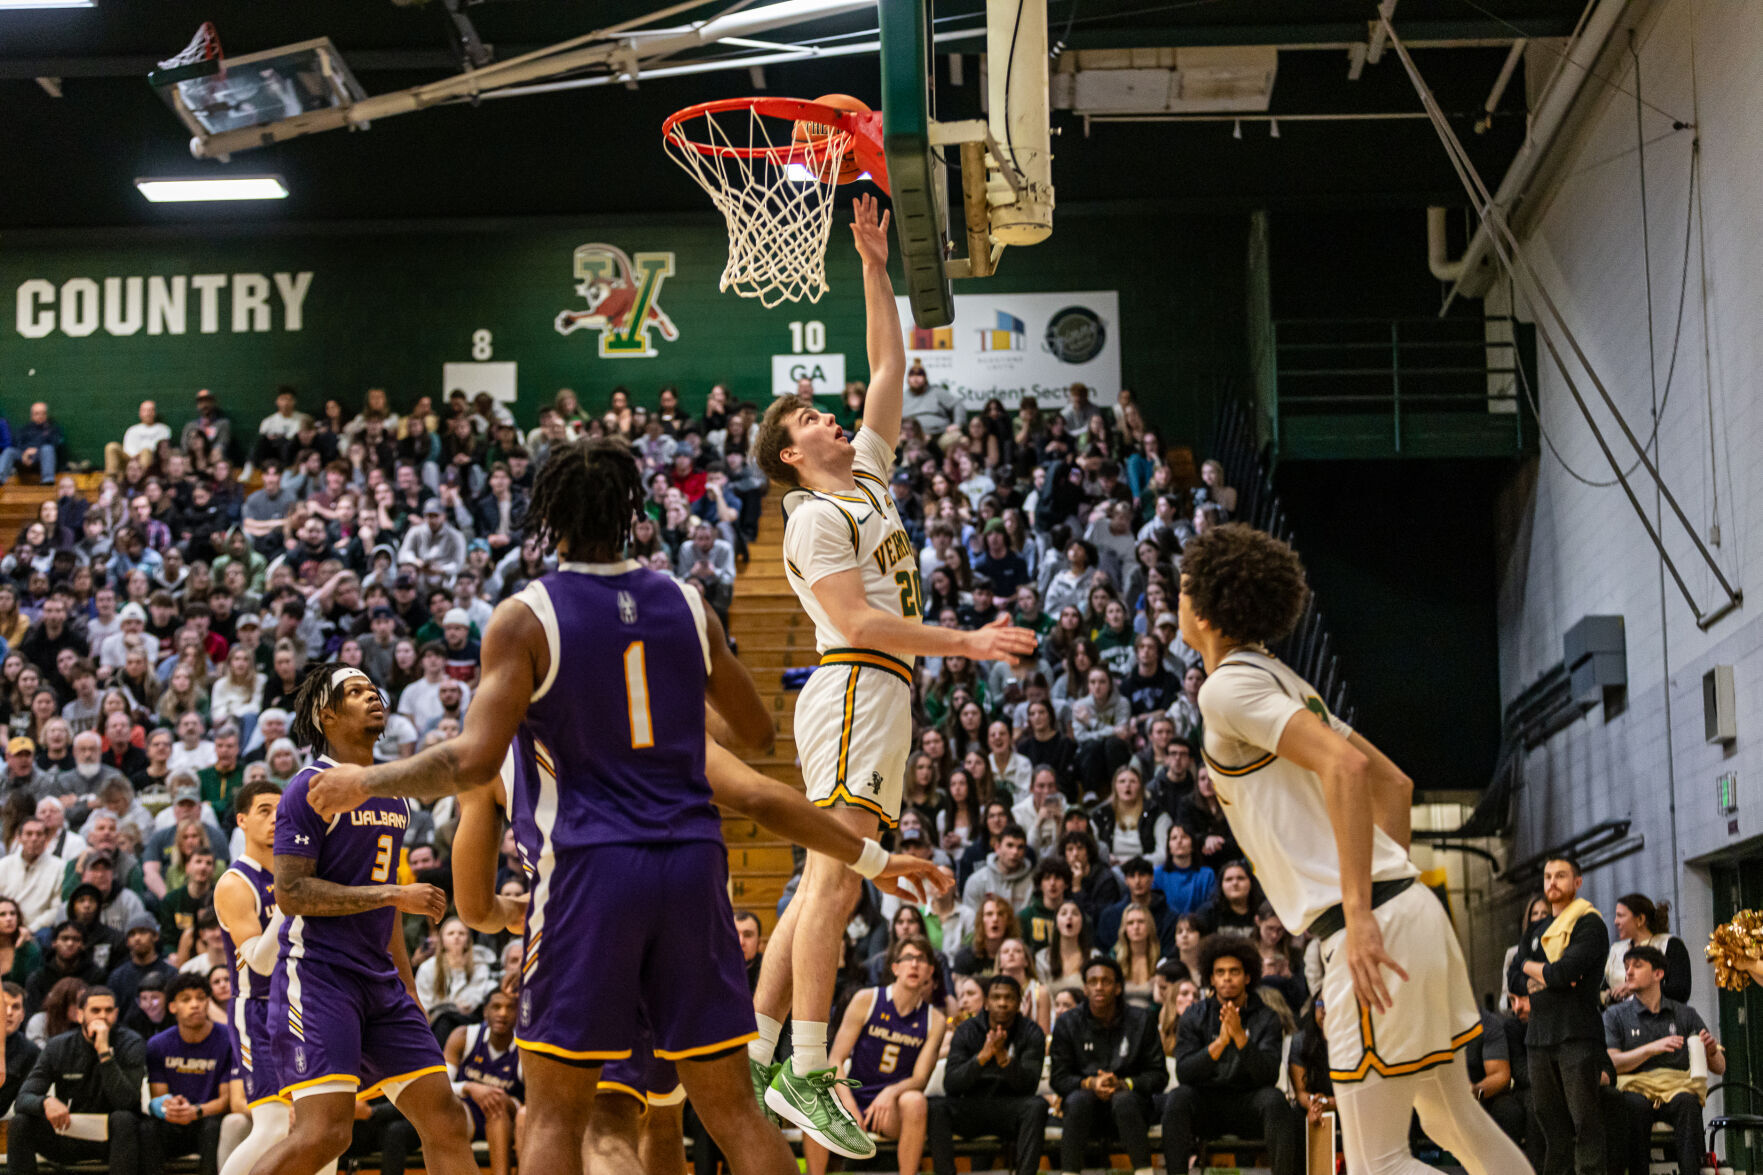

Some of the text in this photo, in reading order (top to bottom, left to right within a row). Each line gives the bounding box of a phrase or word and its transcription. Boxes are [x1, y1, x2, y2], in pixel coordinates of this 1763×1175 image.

[16, 271, 314, 338] COUNTRY
[471, 329, 493, 361] 8
[788, 320, 826, 353] 10
[789, 363, 827, 383] GA
[957, 383, 1097, 401] Student Sectn
[894, 569, 923, 618] 20
[623, 640, 655, 750] 1
[350, 810, 407, 830] UALBANY
[371, 833, 394, 883] 3
[868, 1024, 924, 1048] UALBANY
[879, 1044, 901, 1074] 5
